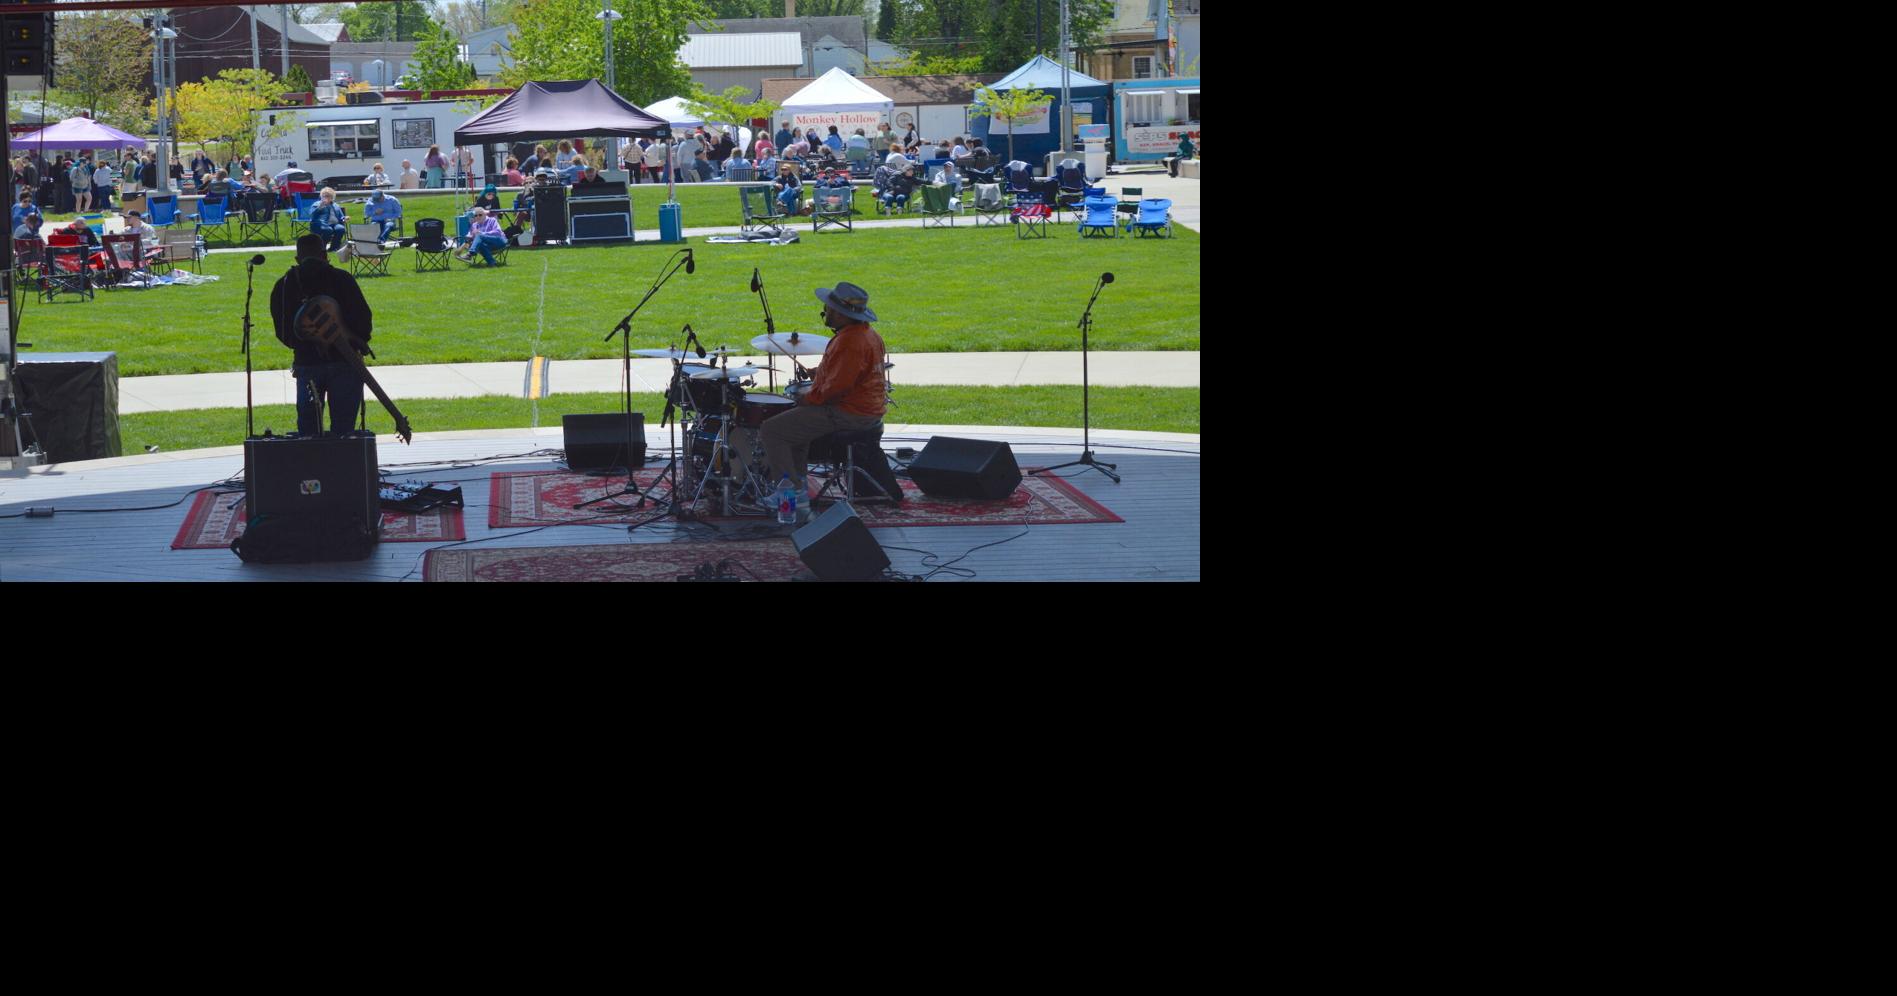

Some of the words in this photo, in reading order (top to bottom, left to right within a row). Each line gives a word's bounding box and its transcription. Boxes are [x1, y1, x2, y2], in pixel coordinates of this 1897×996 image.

[796, 115, 836, 125] Monkey
[841, 114, 877, 124] Hollow
[274, 145, 294, 155] Truck
